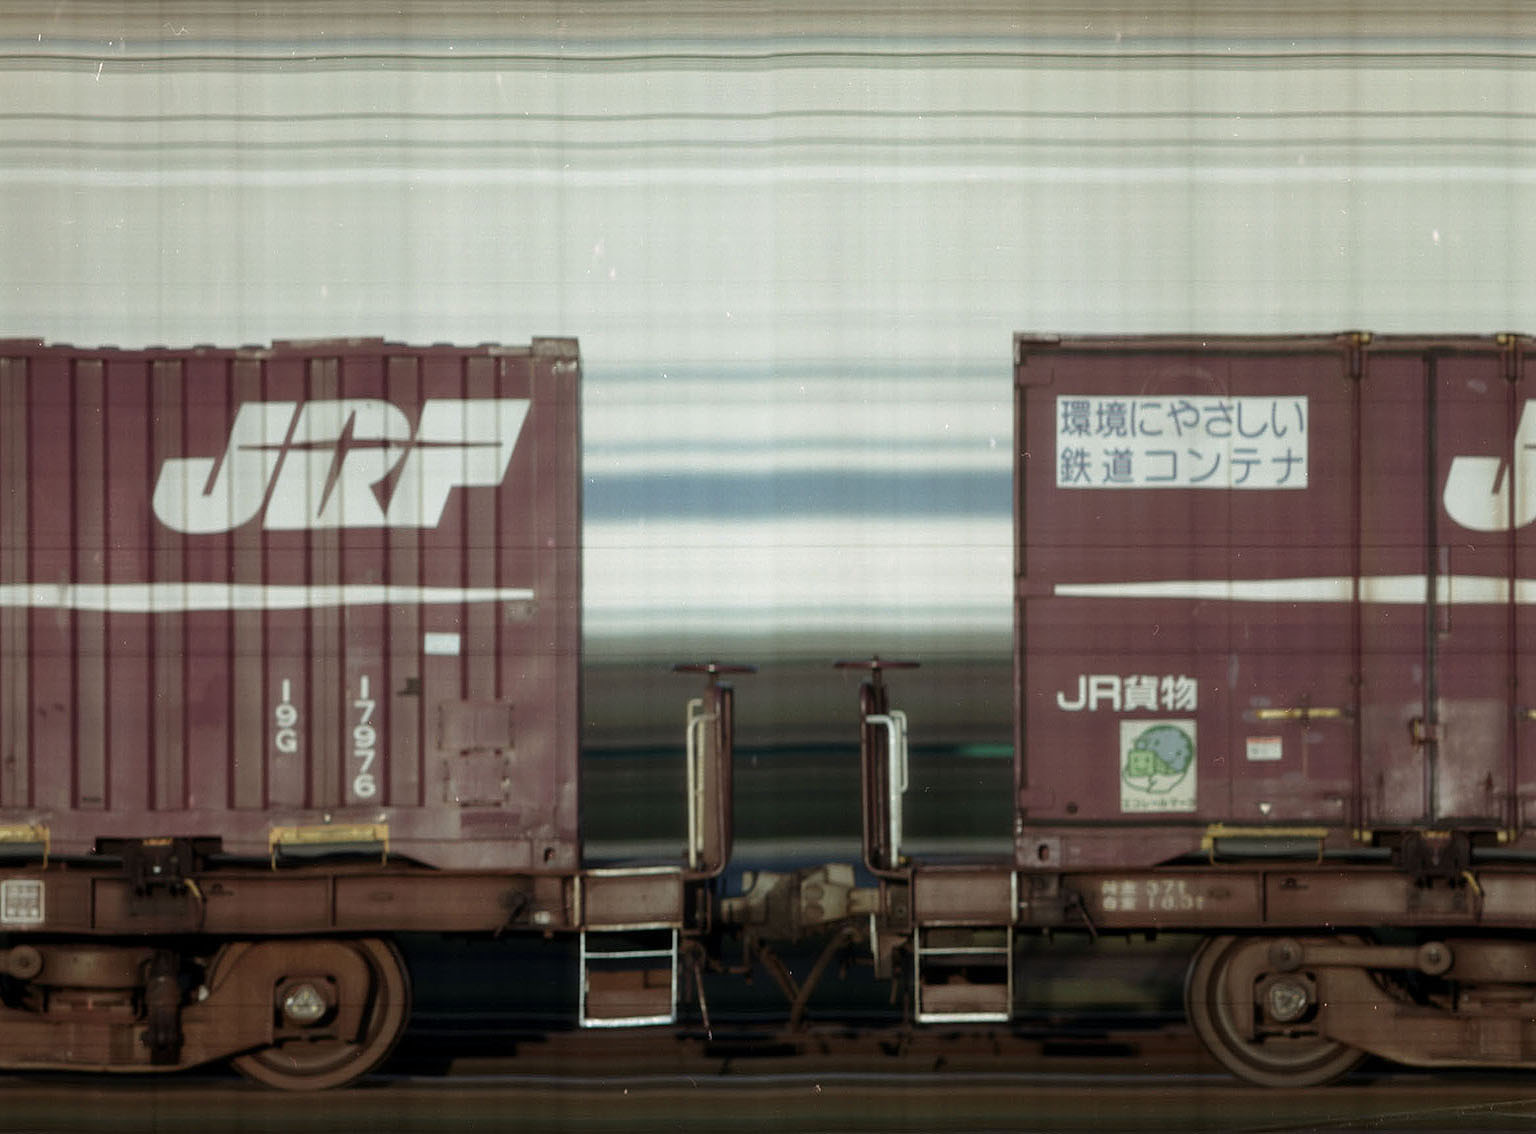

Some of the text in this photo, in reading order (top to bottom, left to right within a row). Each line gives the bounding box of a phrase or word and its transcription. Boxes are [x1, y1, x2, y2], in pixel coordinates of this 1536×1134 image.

[1060, 399, 1305, 439] 環境にやさしい
[153, 399, 531, 534] JRF
[1060, 447, 1304, 485] 鉄道コンテナ
[275, 679, 298, 753] 19G
[1056, 675, 1197, 711] JR貨物
[353, 675, 377, 798] 17976
